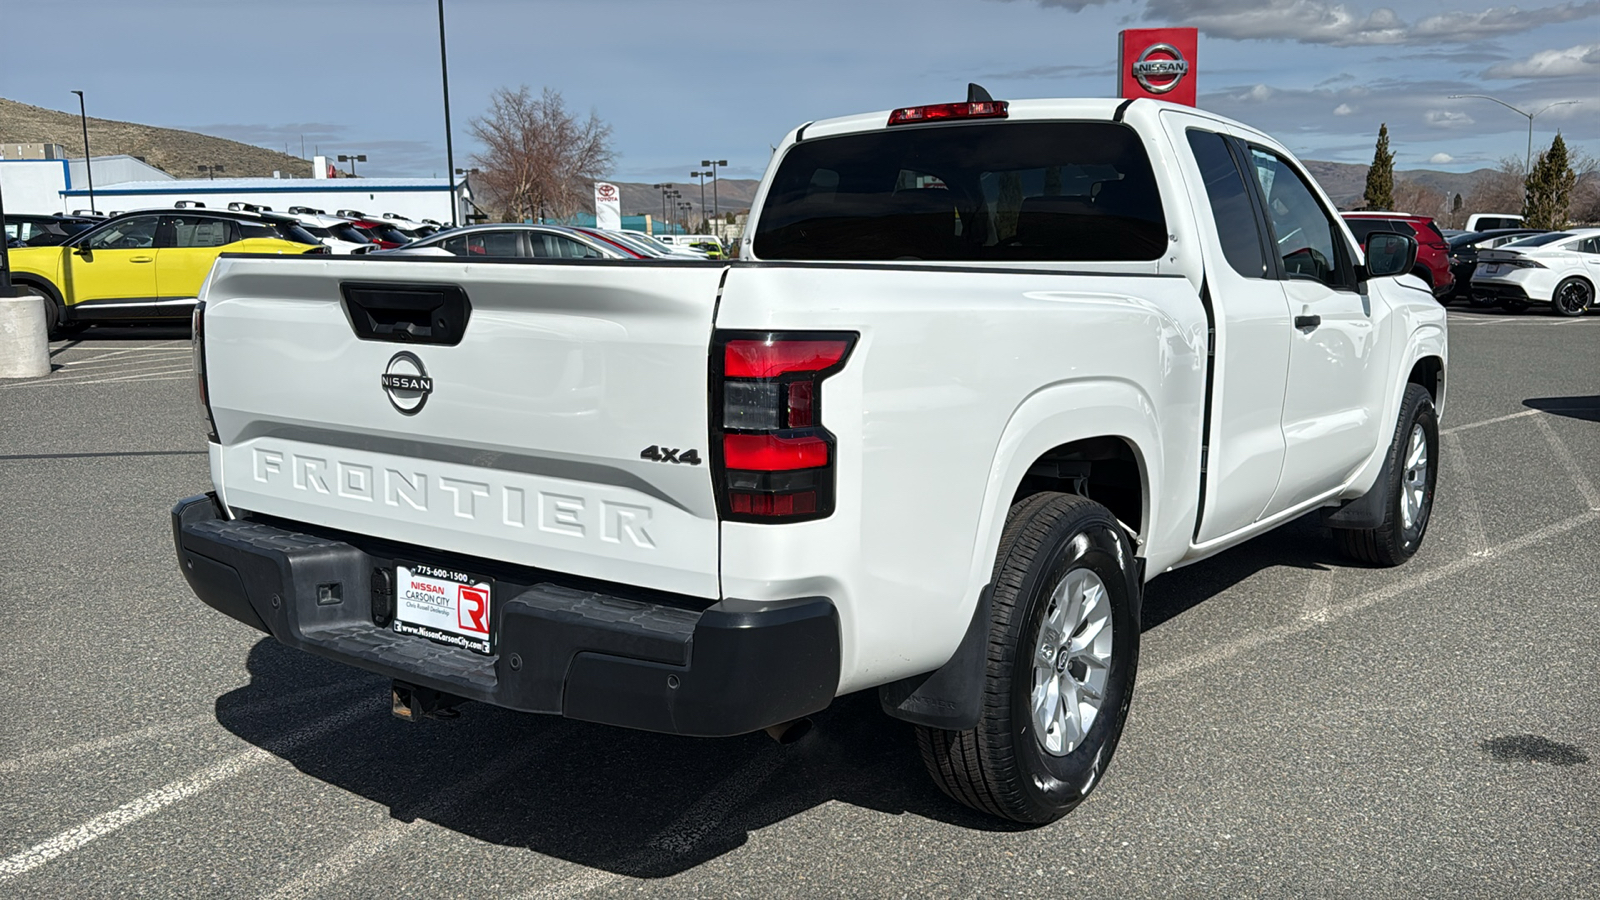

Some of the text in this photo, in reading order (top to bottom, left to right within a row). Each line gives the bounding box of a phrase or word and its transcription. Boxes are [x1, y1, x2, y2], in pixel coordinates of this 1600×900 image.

[1138, 62, 1185, 72] NISSAN
[382, 376, 430, 390] NISSAN
[252, 446, 656, 550] FRONTIER
[417, 565, 468, 582] 775-600-1500
[410, 581, 445, 595] NISSAN
[405, 590, 450, 607] CARSON CITY
[405, 601, 417, 609] Chris
[402, 625, 482, 650] www.NissanCarsonCity.com
